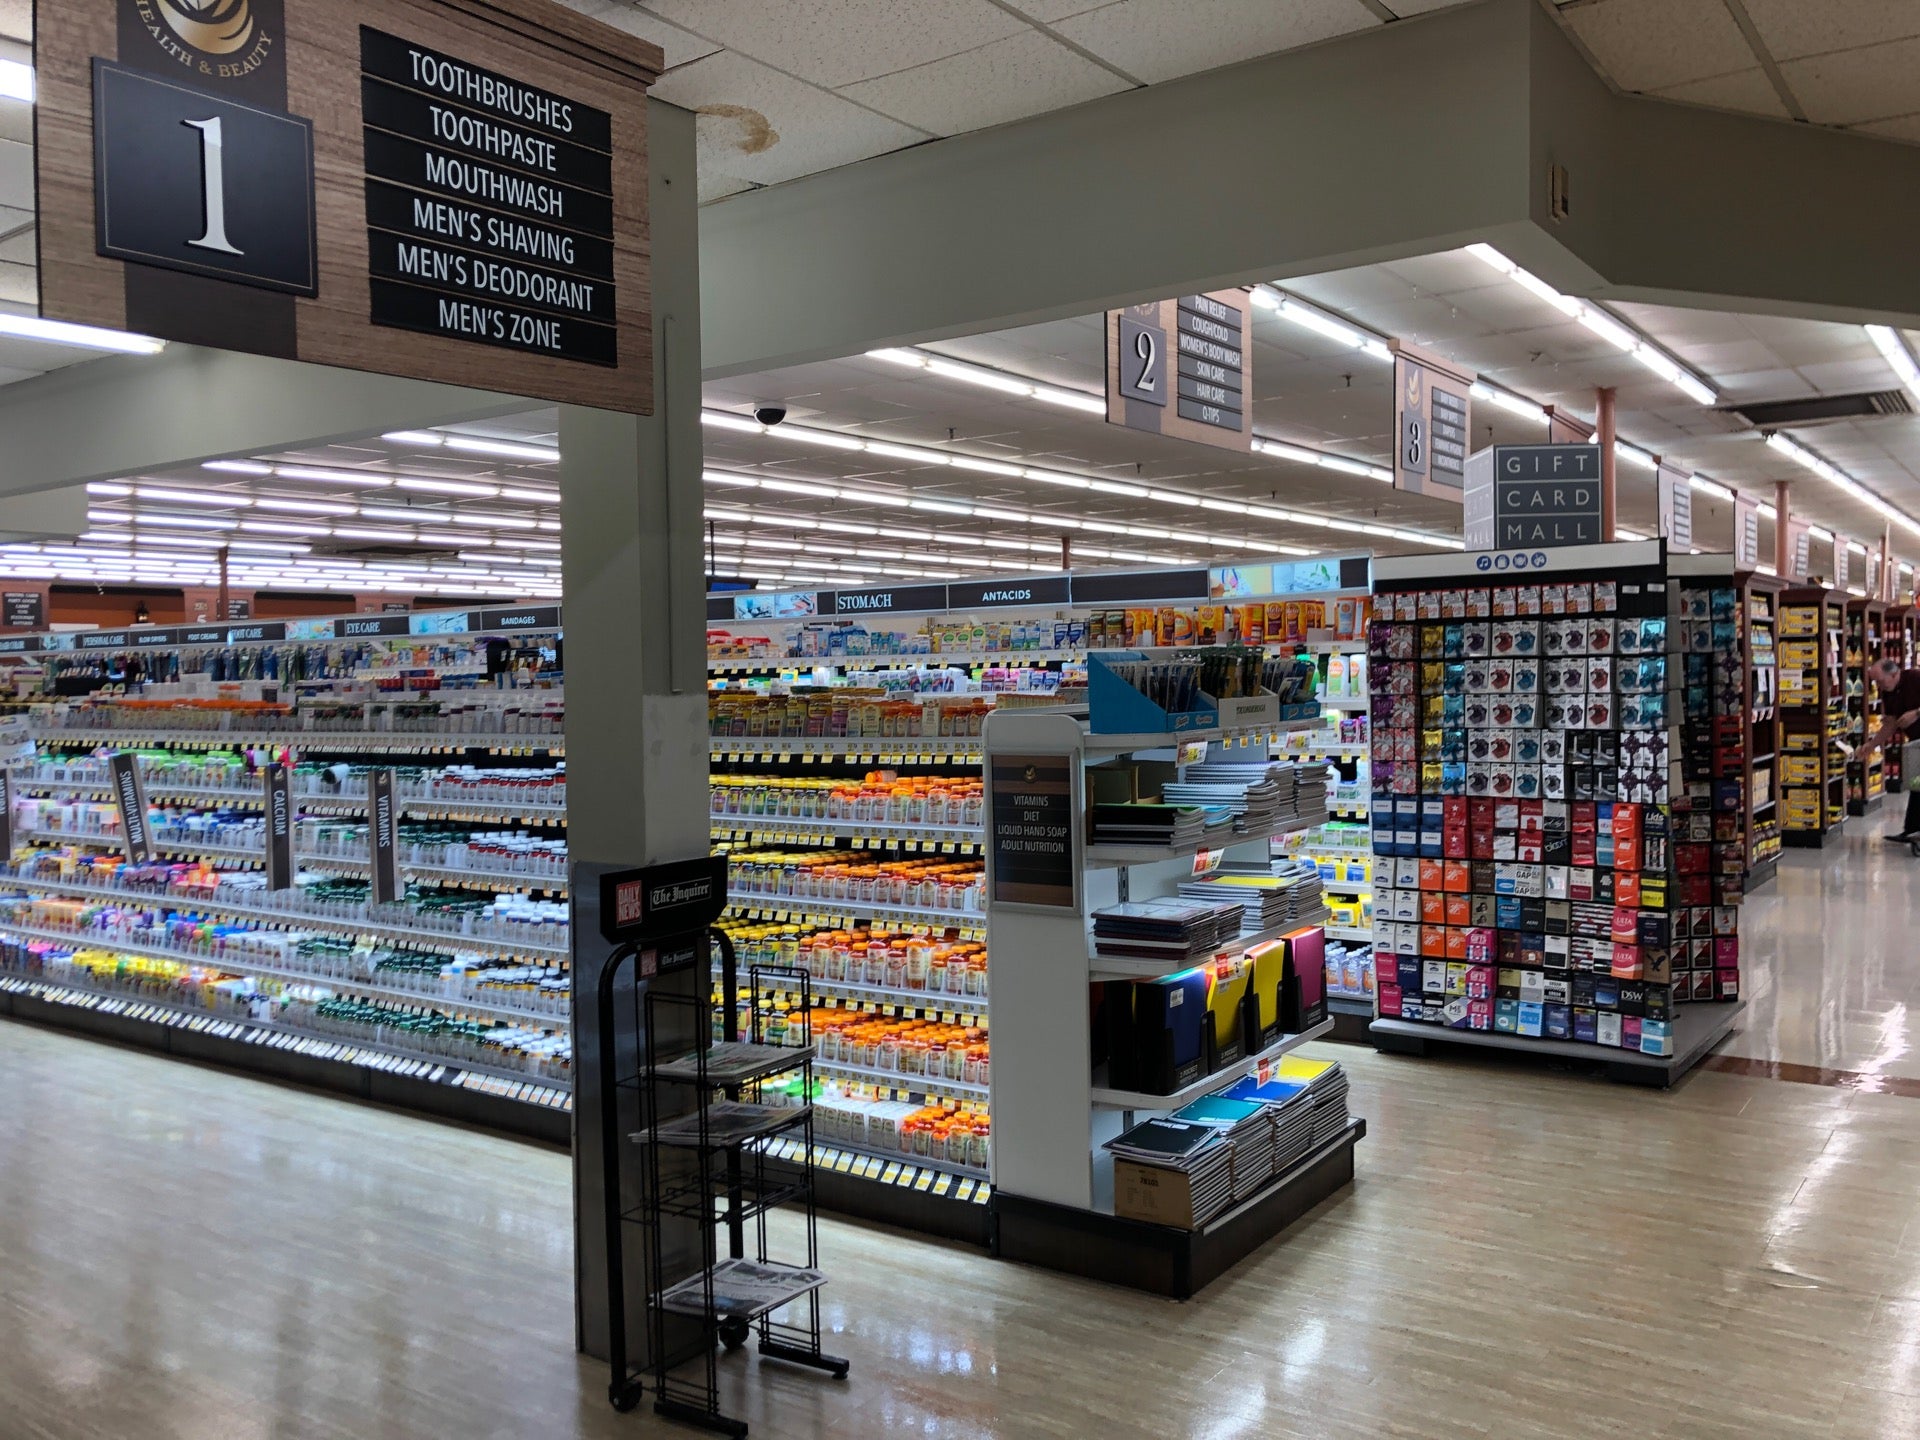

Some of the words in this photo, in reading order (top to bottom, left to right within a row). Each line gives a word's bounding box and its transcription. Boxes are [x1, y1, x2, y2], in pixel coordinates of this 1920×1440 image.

[199, 60, 213, 76] &
[217, 29, 273, 78] BEAUTY
[408, 49, 574, 133] TOOTHBRUSHES
[429, 105, 557, 172] TOOTHPASTE
[181, 115, 246, 257] 1
[426, 152, 563, 217] MOUTHWASH
[413, 198, 482, 242] MEN'S
[487, 217, 574, 264] SHAVING
[398, 242, 467, 285] MEN'S
[473, 260, 593, 312] DEODORANT
[1208, 302, 1227, 320] RELIEF
[439, 299, 504, 339] MEN'S
[509, 314, 562, 350] ZONE
[1180, 334, 1209, 356] WOMEN'S
[1136, 331, 1156, 392] 2
[1197, 361, 1211, 378] SKIN
[1210, 368, 1225, 383] CARE
[1196, 383, 1211, 398] HAIR
[1210, 389, 1225, 404] CARE
[1202, 405, 1220, 424] Q-TIPS
[1409, 420, 1421, 465] 3
[1506, 455, 1589, 473] GIFT
[1506, 489, 1590, 507] CARD
[1507, 523, 1588, 541] MALL
[838, 593, 893, 610] STOMACH
[981, 589, 1032, 602] ANTACIDS
[346, 623, 361, 634] EYE
[361, 621, 381, 633] CARE
[500, 615, 537, 626] BANDAGES
[246, 627, 264, 638] CARE
[119, 769, 144, 845] MULTI-VITAMINS
[1013, 795, 1049, 807] VITAMINS
[271, 789, 288, 836] CALCIUM
[376, 794, 390, 849] VITAMINS
[1023, 811, 1041, 822] DIET
[1645, 812, 1665, 822] Lids
[997, 825, 1023, 836] LIQUID
[1023, 826, 1046, 837] HAND
[1047, 826, 1068, 838] SOAP
[1001, 839, 1024, 851] ADULT
[1024, 841, 1065, 853] NUTRITION
[652, 888, 672, 906] The
[671, 882, 710, 903] Inquirer
[619, 901, 641, 921] NEWS
[1621, 990, 1644, 1000] DSW
